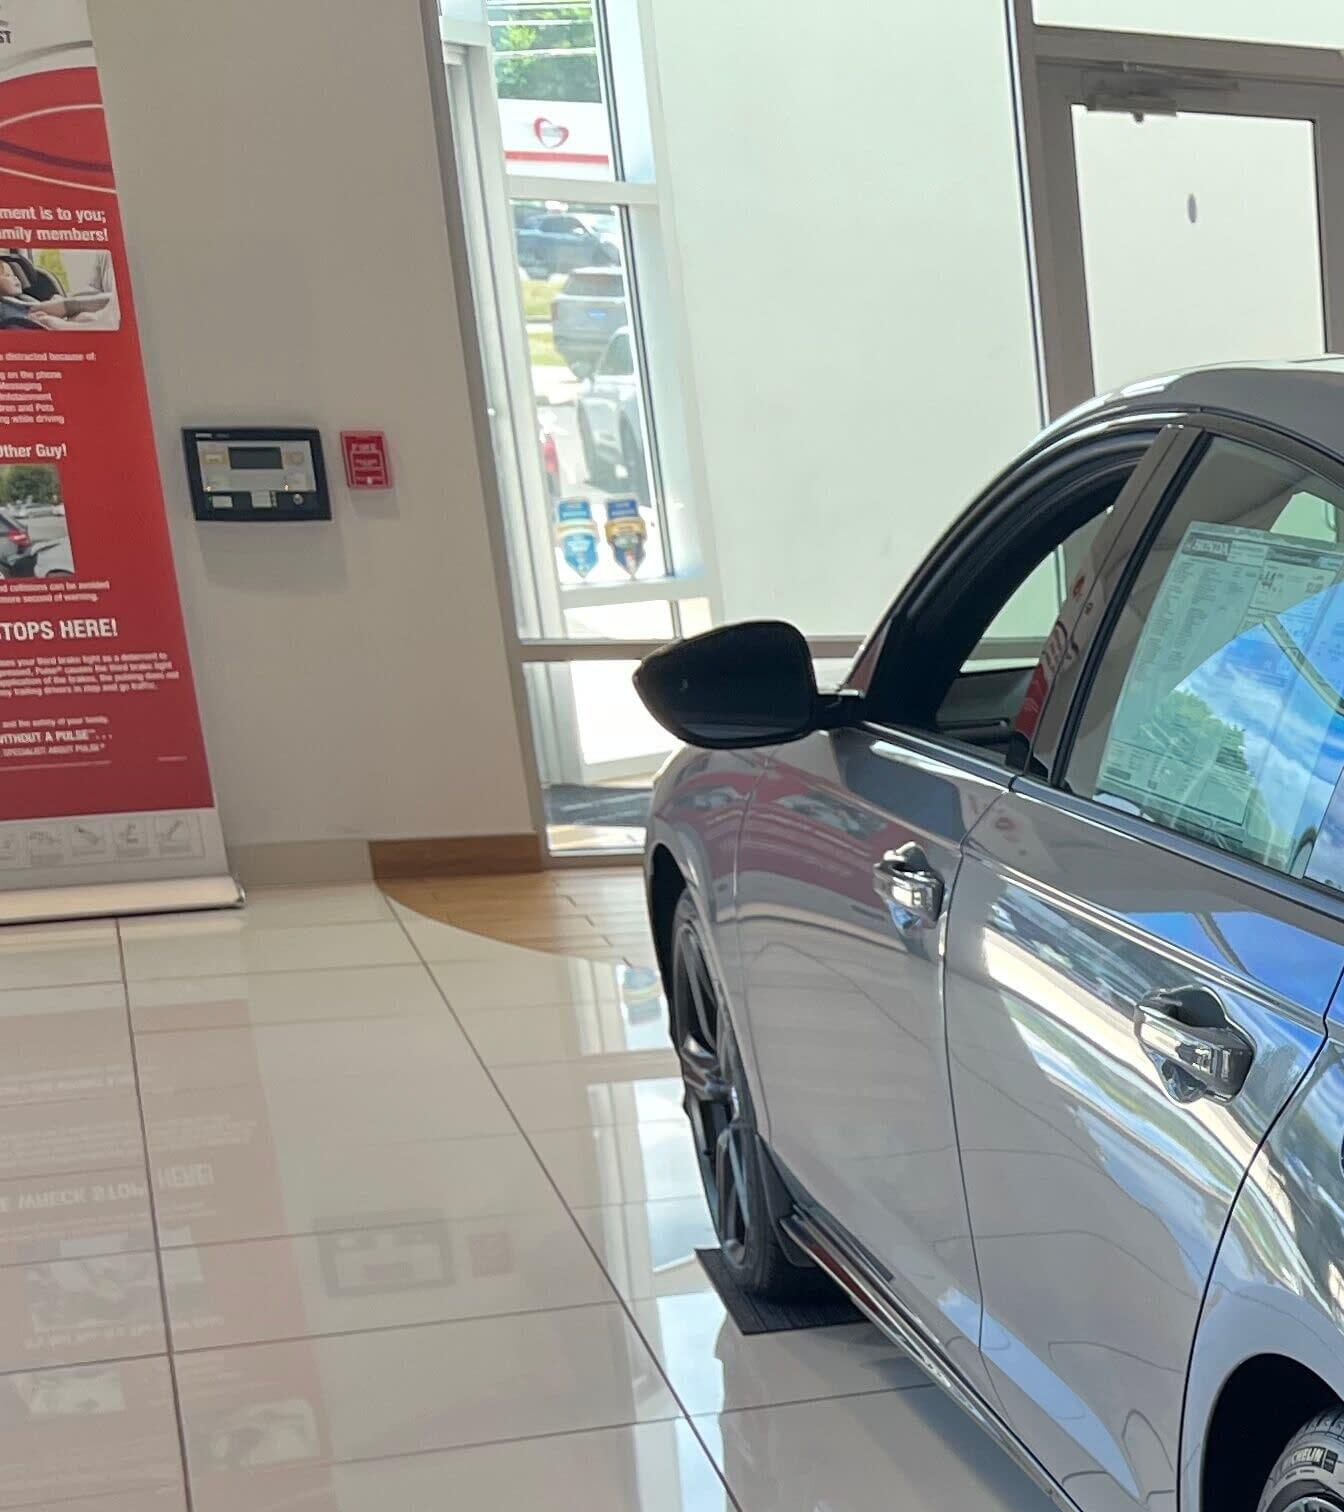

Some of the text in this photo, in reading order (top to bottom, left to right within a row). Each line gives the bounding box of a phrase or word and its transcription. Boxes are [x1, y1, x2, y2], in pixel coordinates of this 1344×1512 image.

[39, 206, 54, 220] is
[57, 207, 72, 221] to
[59, 618, 119, 639] HERE!
[45, 731, 53, 742] A
